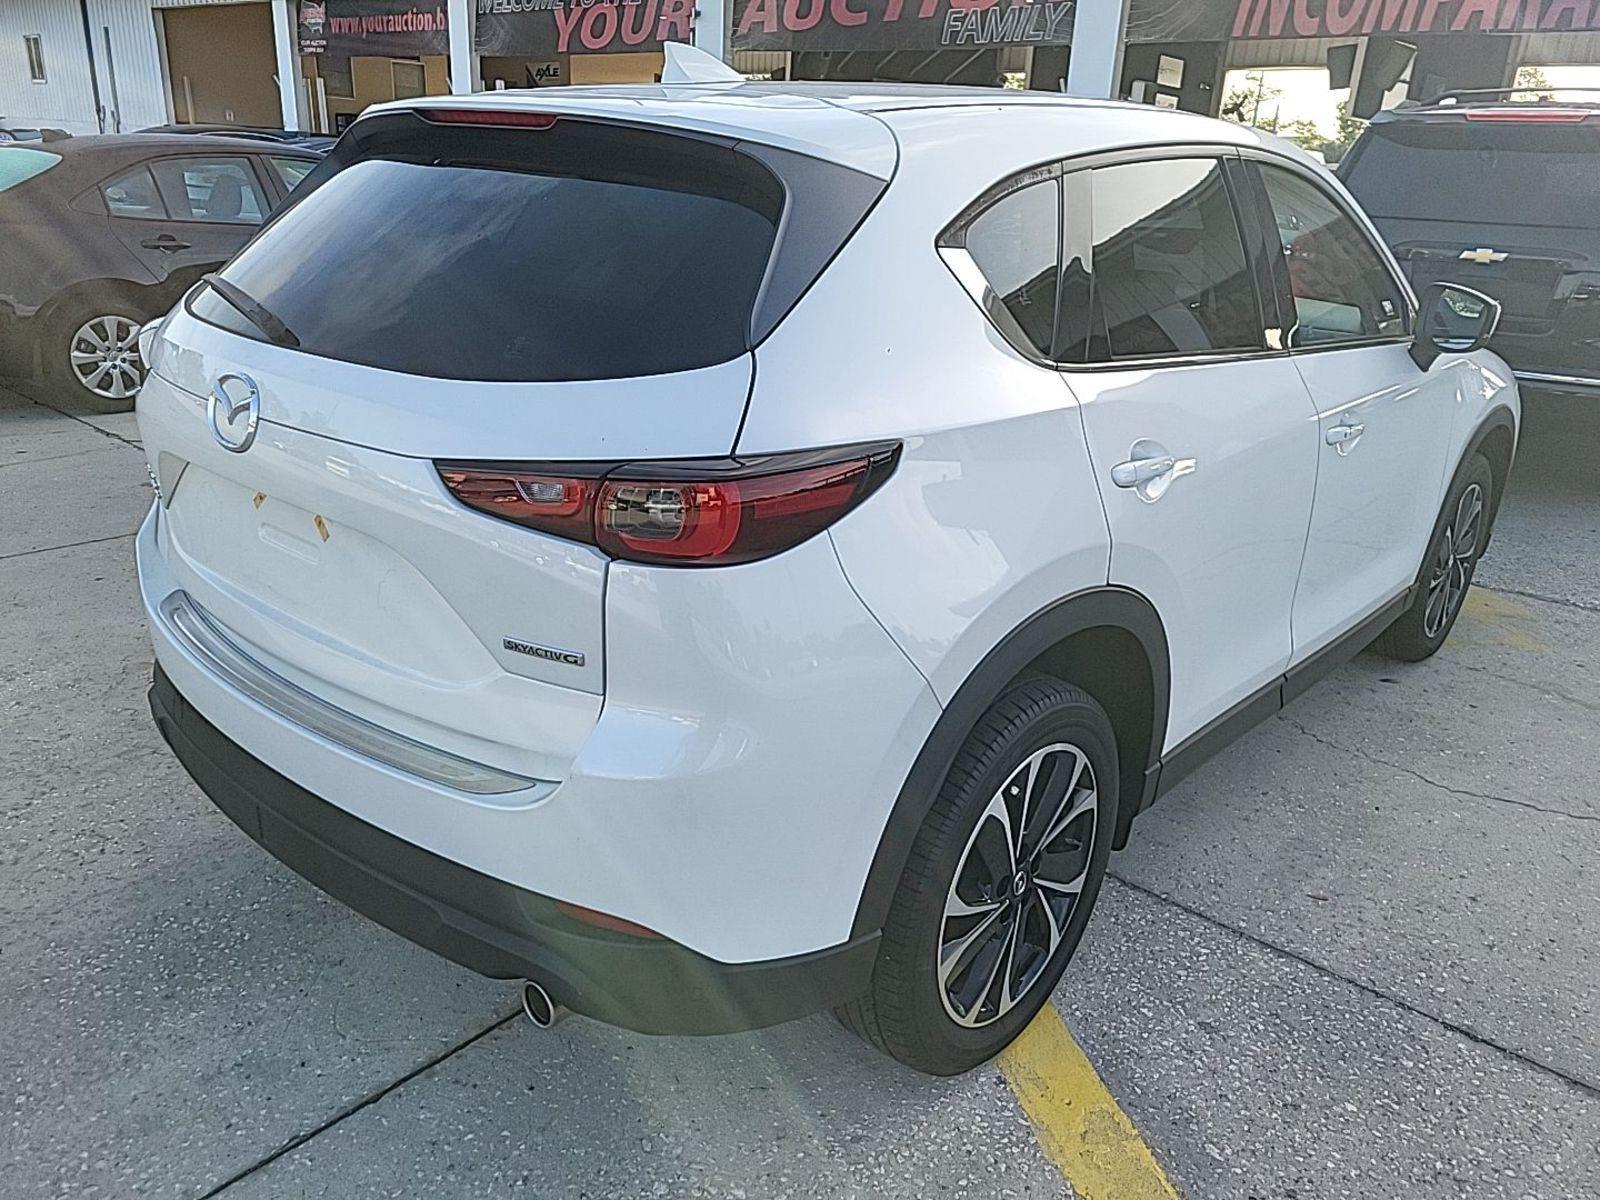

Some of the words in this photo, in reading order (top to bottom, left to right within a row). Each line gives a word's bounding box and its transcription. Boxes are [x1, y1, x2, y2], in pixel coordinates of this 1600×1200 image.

[553, 3, 692, 52] YOUR
[941, 2, 1073, 44] FAMILY
[535, 64, 559, 81] AXLE
